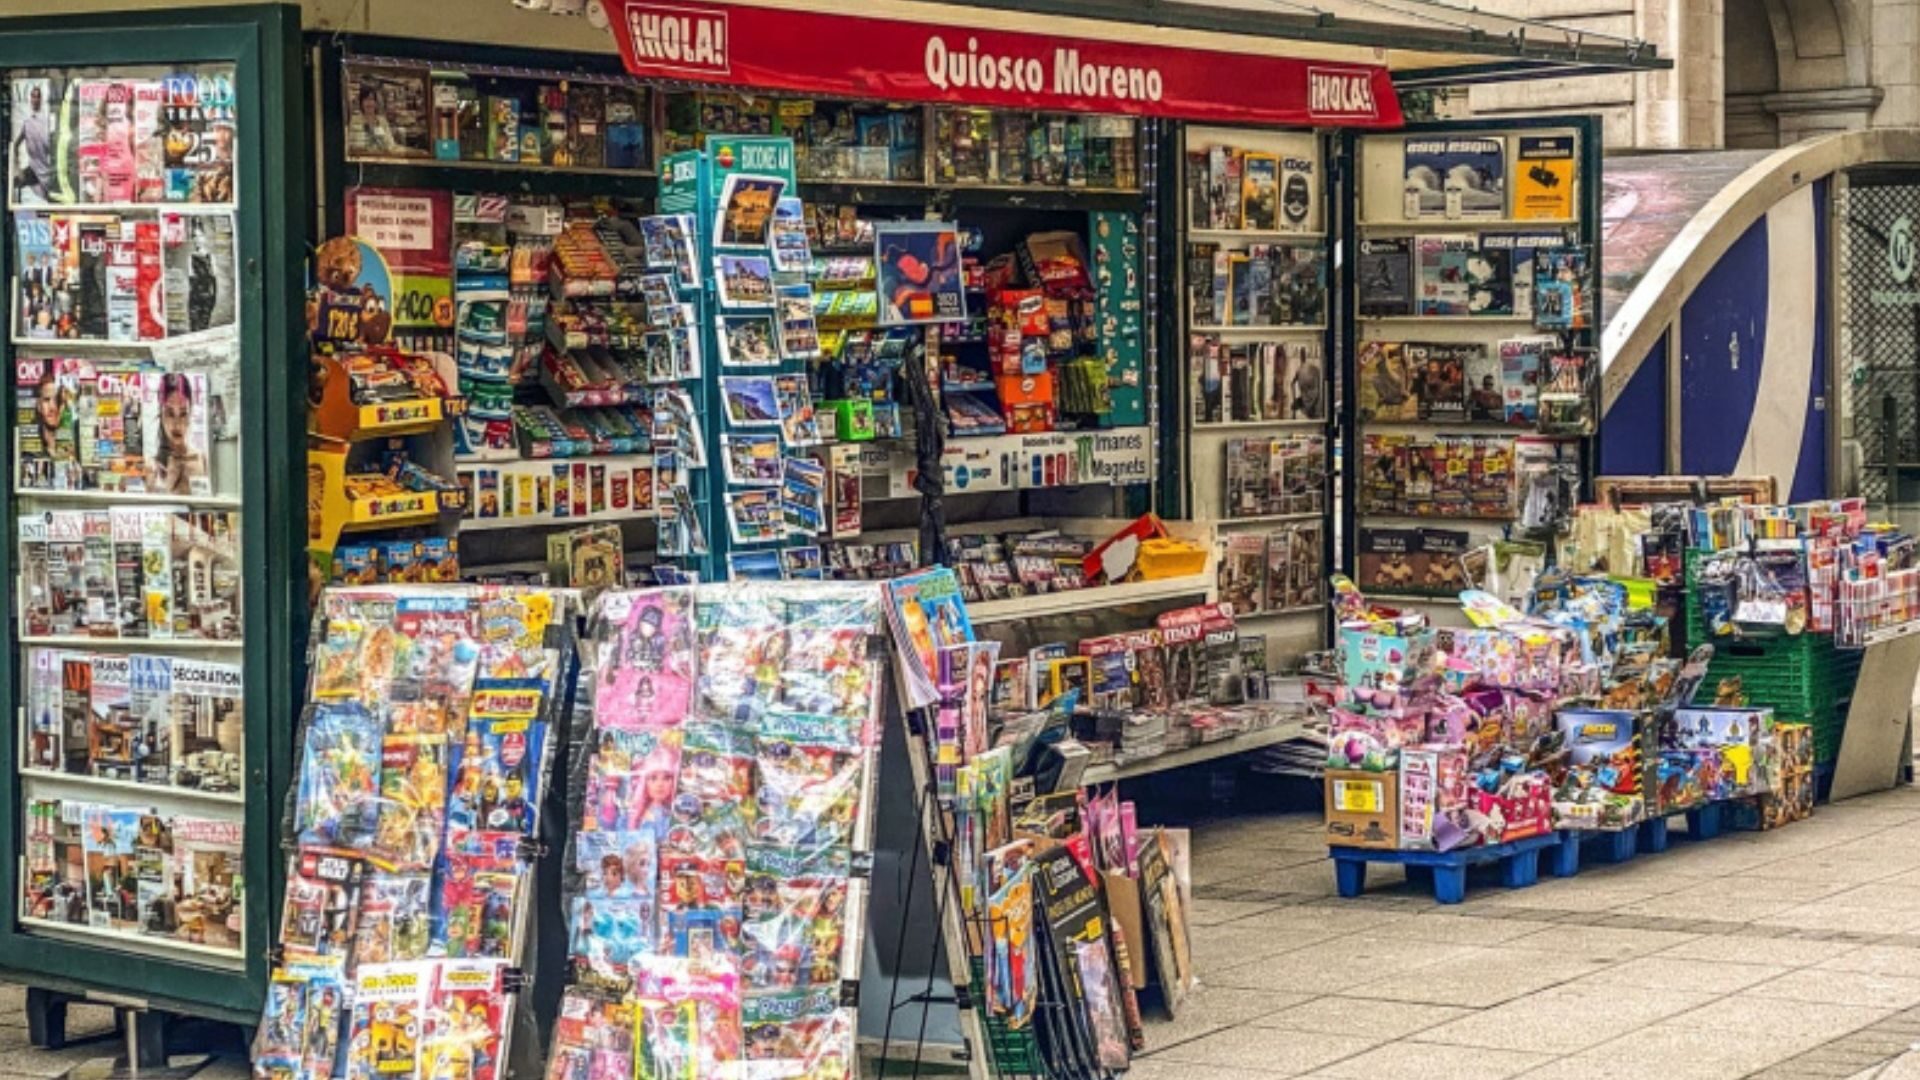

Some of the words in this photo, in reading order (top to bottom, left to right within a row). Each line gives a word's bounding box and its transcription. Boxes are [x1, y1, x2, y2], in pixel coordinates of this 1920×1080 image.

[632, 13, 724, 65] ¡HOLA!
[924, 36, 1043, 92] Quiosco
[1053, 48, 1163, 101] Moreno
[1311, 72, 1373, 112] ¡HOLA!
[1095, 434, 1143, 451] Imanes
